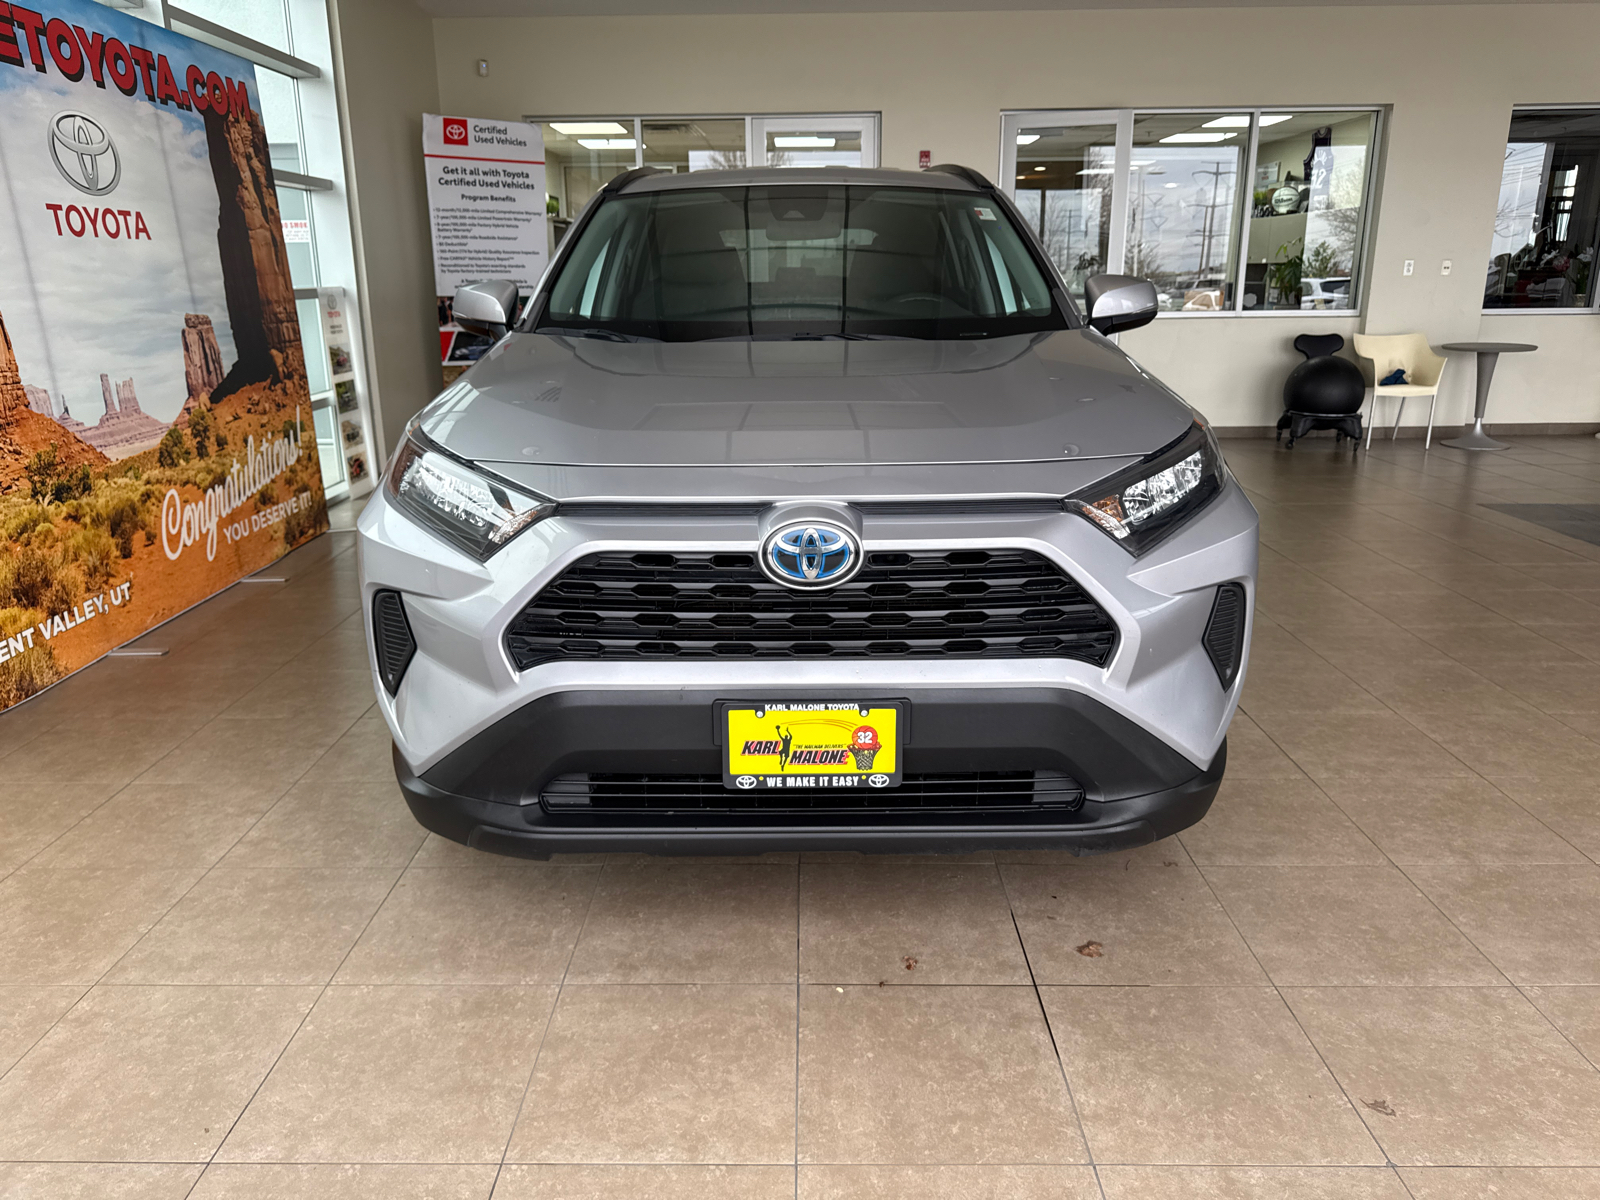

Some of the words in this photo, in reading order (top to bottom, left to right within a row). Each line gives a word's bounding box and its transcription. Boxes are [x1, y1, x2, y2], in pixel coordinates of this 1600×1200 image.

[473, 124, 508, 135] Certified
[474, 135, 494, 144] Used
[496, 137, 527, 147] Vehicles
[442, 166, 459, 175] Get
[460, 167, 468, 175] it
[469, 167, 480, 176] all
[482, 168, 501, 177] with
[502, 170, 530, 179] Toyota
[438, 177, 477, 187] Certified
[478, 178, 500, 188] Used
[501, 180, 535, 190] Vehicles
[461, 194, 489, 203] Program
[490, 195, 516, 203] Benefits
[45, 203, 152, 240] TOYOTA
[161, 403, 303, 562] Congratulations!
[223, 515, 250, 544] YOU
[251, 495, 299, 532] DESERVE
[299, 490, 313, 510] IT!
[0, 627, 35, 664] ENT
[38, 593, 109, 641] VALLEY,
[109, 581, 131, 606] UT
[790, 703, 826, 711] MALONE
[827, 703, 860, 711] TOYOTA
[857, 731, 873, 744] 32
[741, 740, 781, 756] KARL
[788, 749, 850, 765] MALONE
[766, 776, 783, 787] WE
[786, 776, 816, 787] MAKE
[819, 776, 829, 787] IT
[833, 775, 859, 787] EASY
